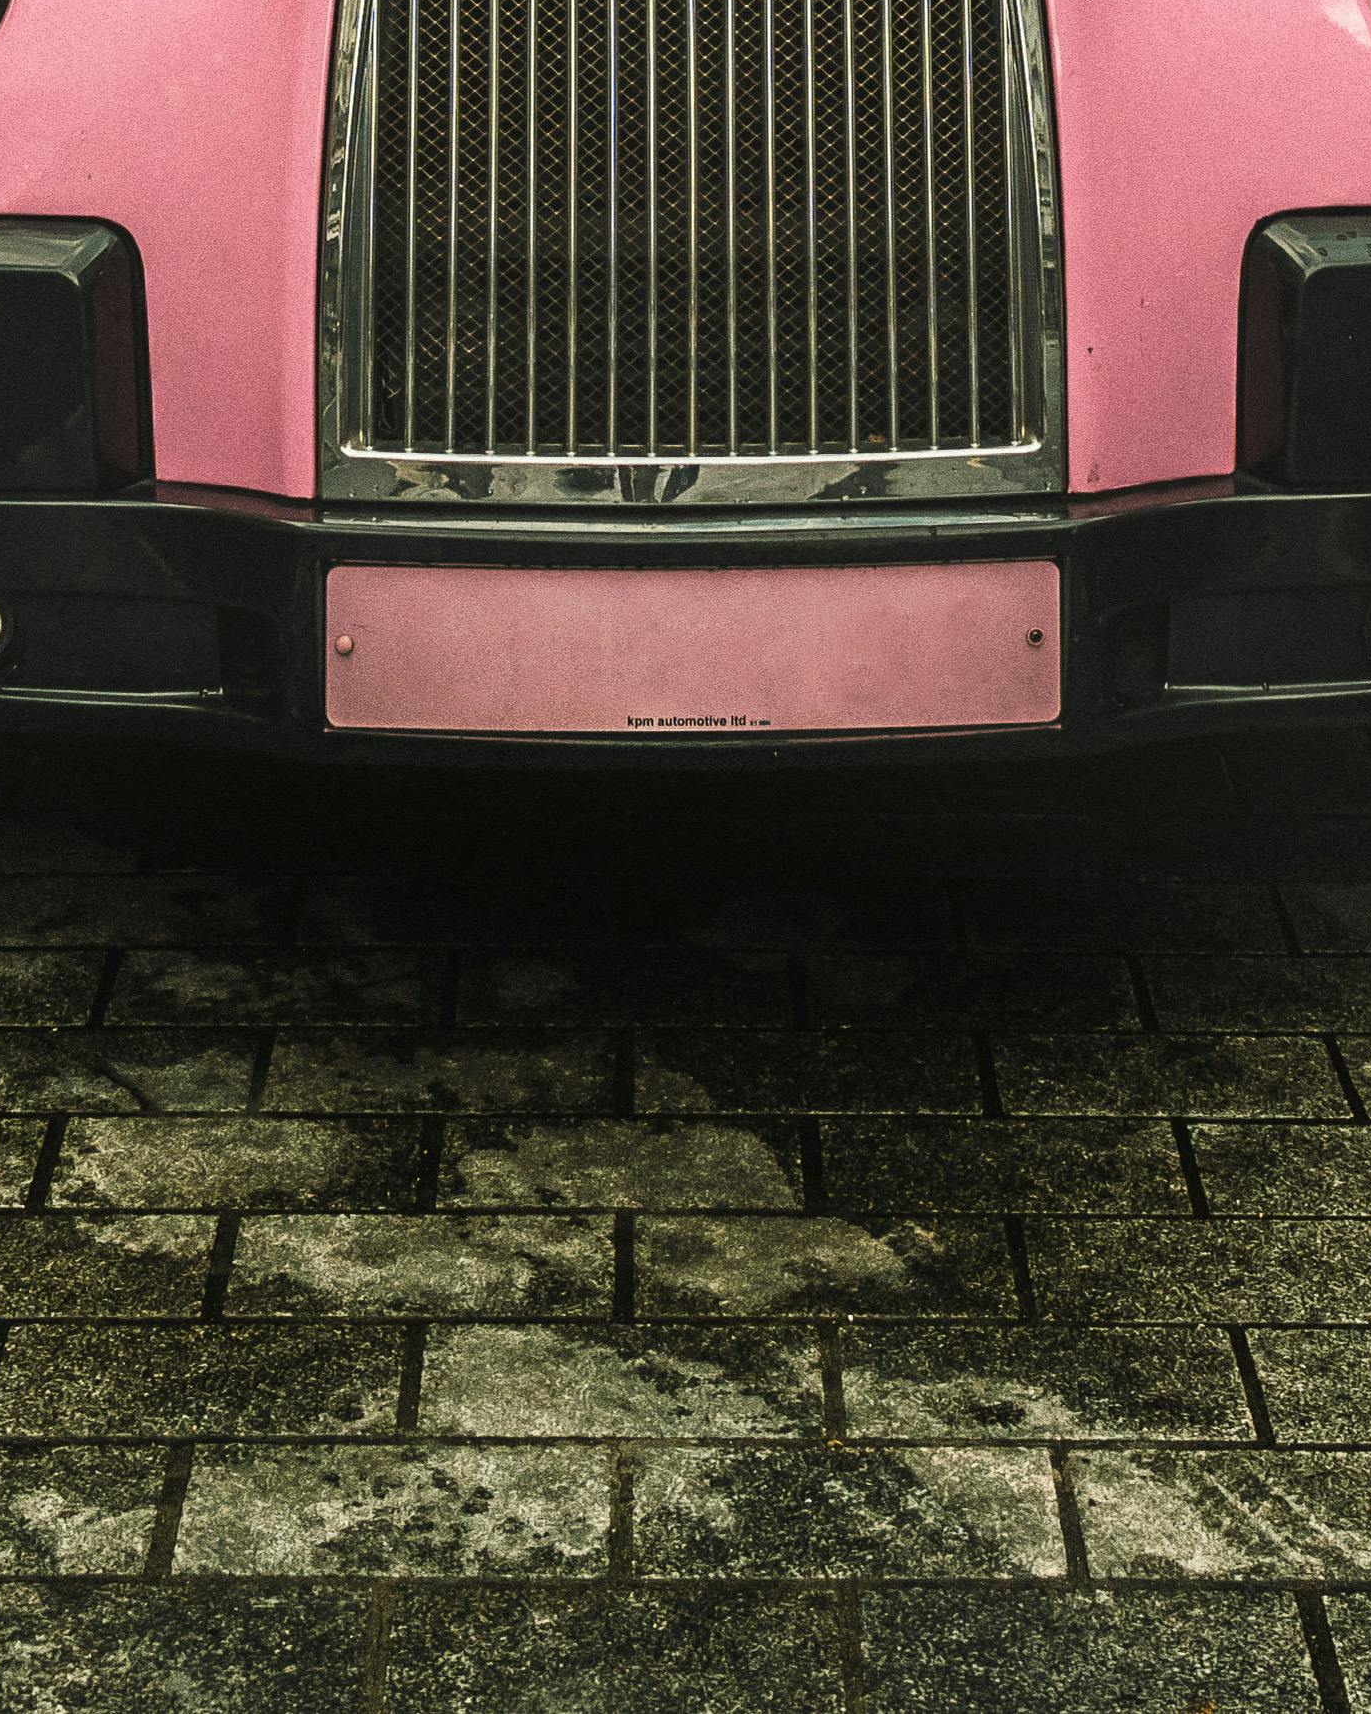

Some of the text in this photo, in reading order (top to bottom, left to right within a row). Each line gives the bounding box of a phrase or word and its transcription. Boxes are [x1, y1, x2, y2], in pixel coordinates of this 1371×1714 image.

[627, 715, 654, 729] kpm
[657, 715, 727, 727] automotive
[731, 715, 746, 726] ltd
